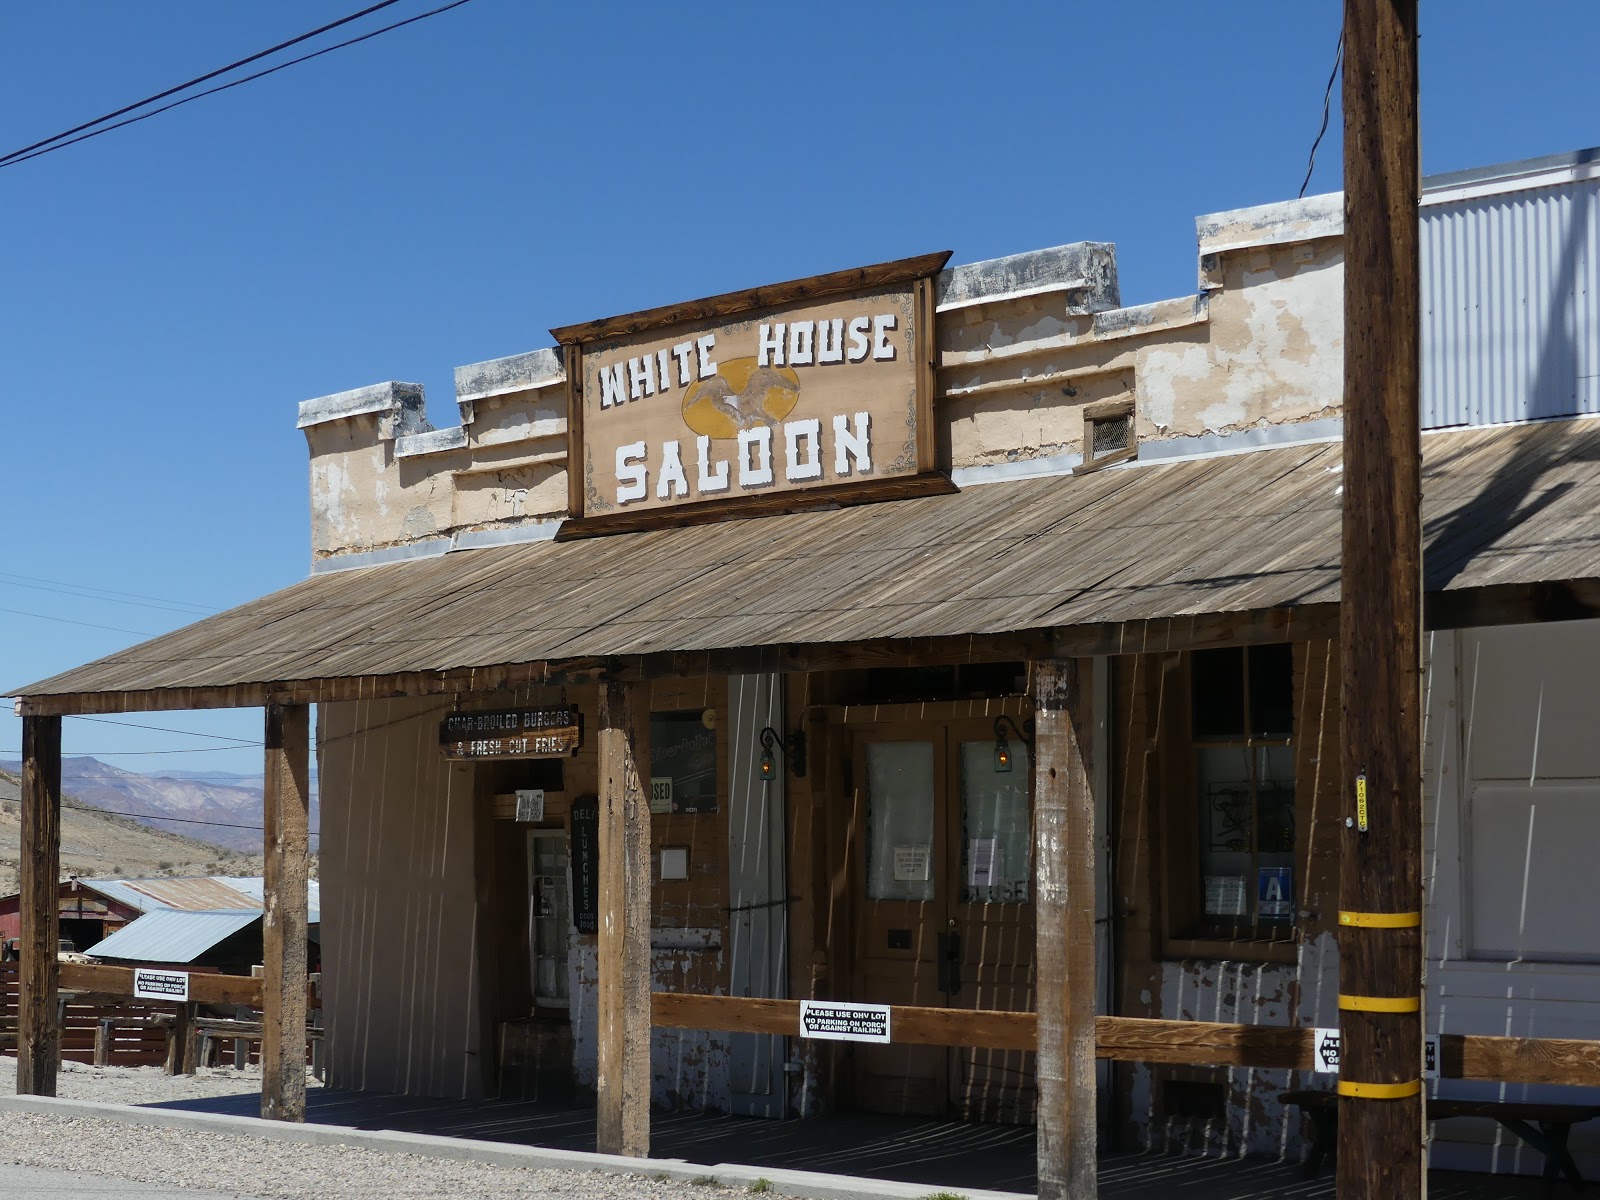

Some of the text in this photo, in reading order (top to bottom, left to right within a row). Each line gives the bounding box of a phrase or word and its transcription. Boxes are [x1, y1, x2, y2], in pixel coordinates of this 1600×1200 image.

[600, 314, 896, 408] WHITE HOUSE
[615, 411, 872, 504] SALOON
[448, 711, 569, 731] CHAR-BROILED BURGERS
[456, 736, 564, 756] & FRESH CUT FRIES
[573, 808, 595, 821] DELI
[581, 825, 589, 910] LUNCHES
[1265, 876, 1283, 900] A
[806, 1009, 834, 1017] PLEASE
[817, 1018, 848, 1026] PARKING
[820, 1024, 851, 1032] AGAINST
